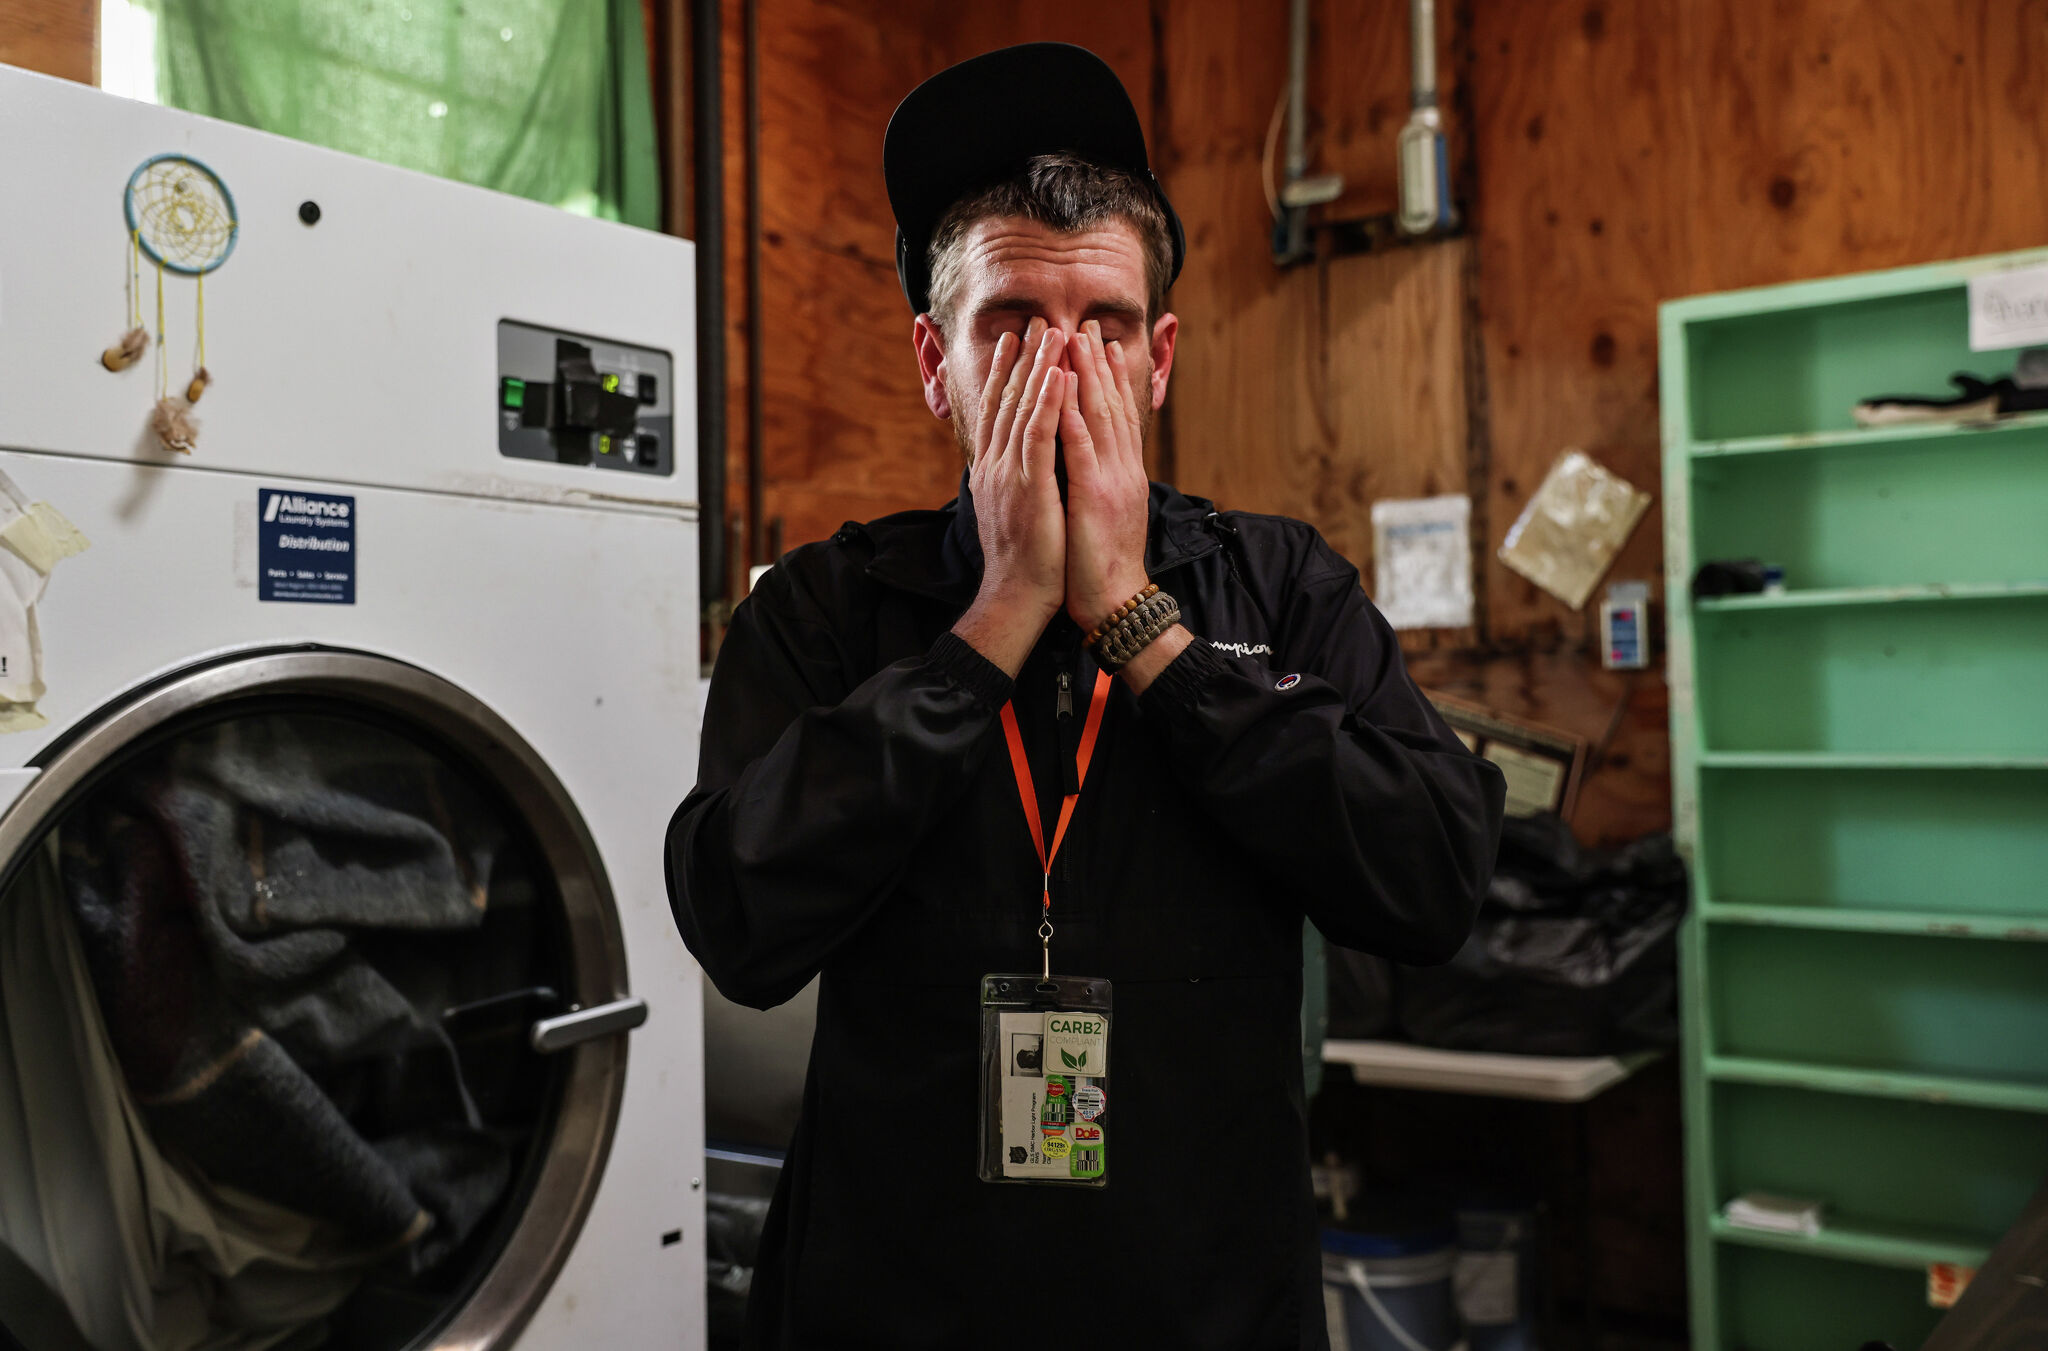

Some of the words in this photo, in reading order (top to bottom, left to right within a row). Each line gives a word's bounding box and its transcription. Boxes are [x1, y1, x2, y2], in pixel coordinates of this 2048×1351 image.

[278, 495, 350, 518] Alliance
[278, 514, 313, 527] Laundry
[315, 517, 350, 528] Systems
[278, 534, 350, 553] Distribution
[1209, 640, 1274, 658] mpion
[1050, 1020, 1102, 1035] CARB2
[1076, 1127, 1100, 1138] Dole
